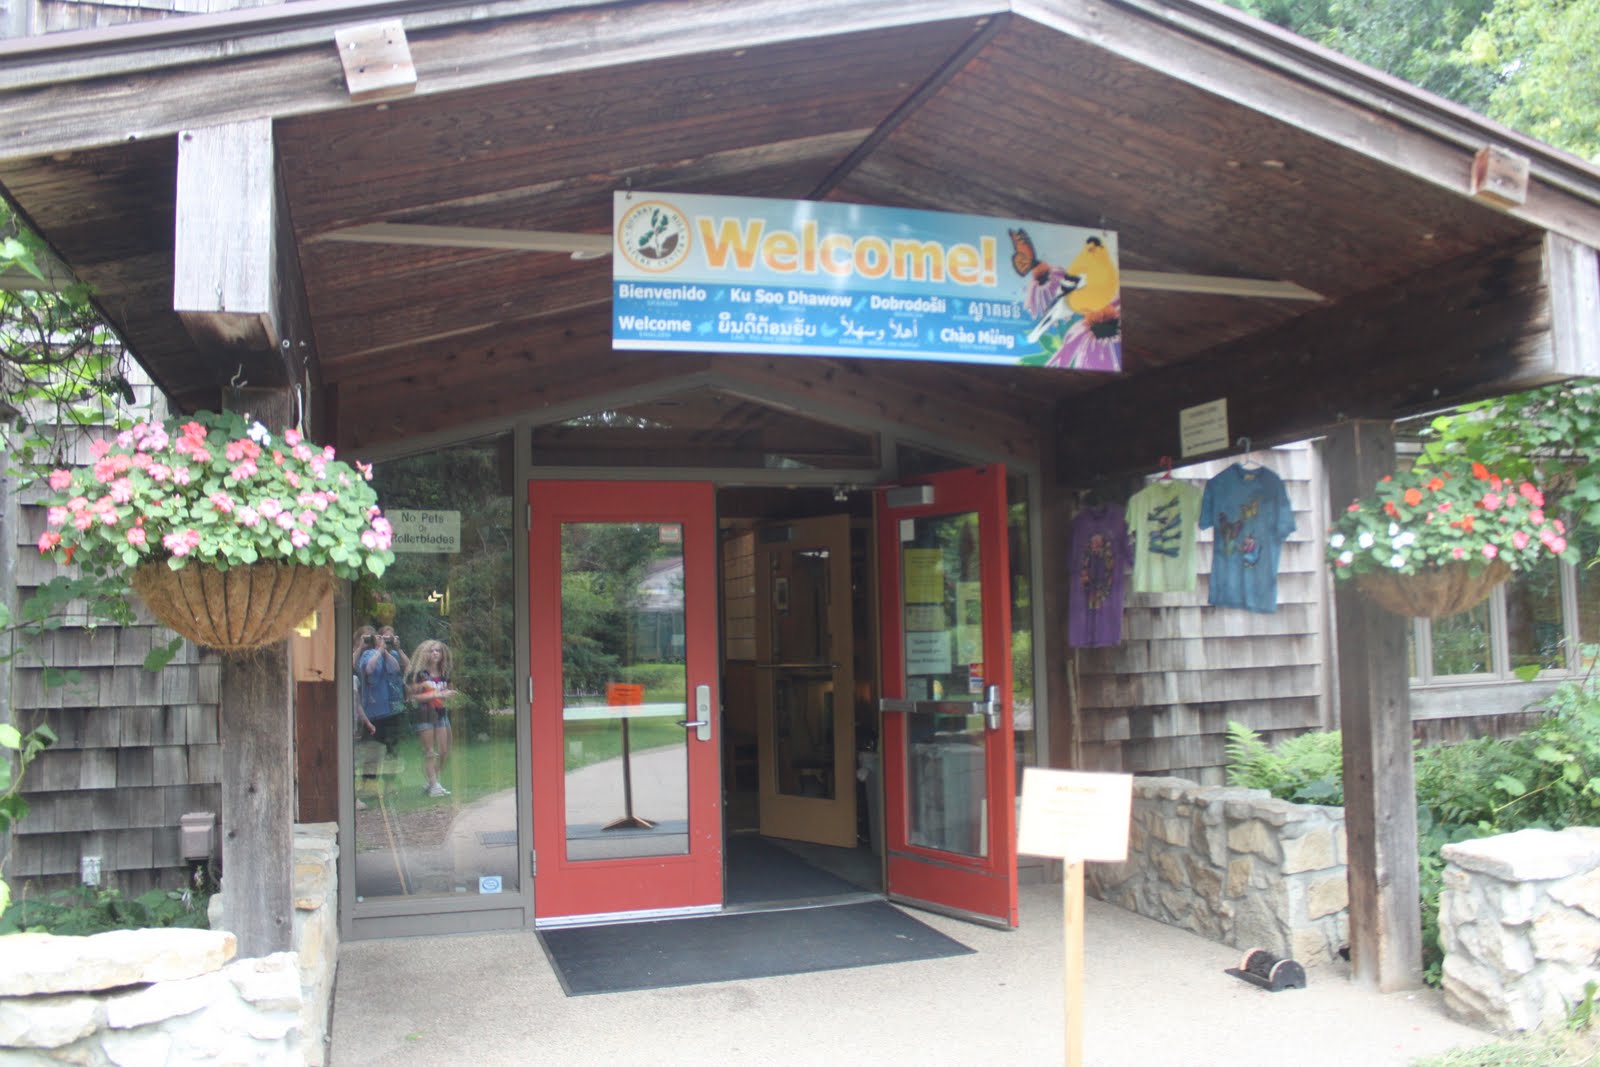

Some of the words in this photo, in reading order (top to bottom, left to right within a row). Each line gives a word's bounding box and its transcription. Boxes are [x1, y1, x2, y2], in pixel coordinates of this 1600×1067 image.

[698, 217, 997, 286] Welcome!
[619, 284, 707, 301] Bienvenido
[730, 287, 751, 303] Ku
[755, 288, 784, 304] Soo
[788, 290, 852, 307] Dhawow
[870, 294, 946, 313] Dobrodošli
[618, 315, 692, 333] Welcome
[401, 511, 416, 522] No
[421, 512, 444, 524] Pets
[391, 533, 455, 544] Rollerblades
